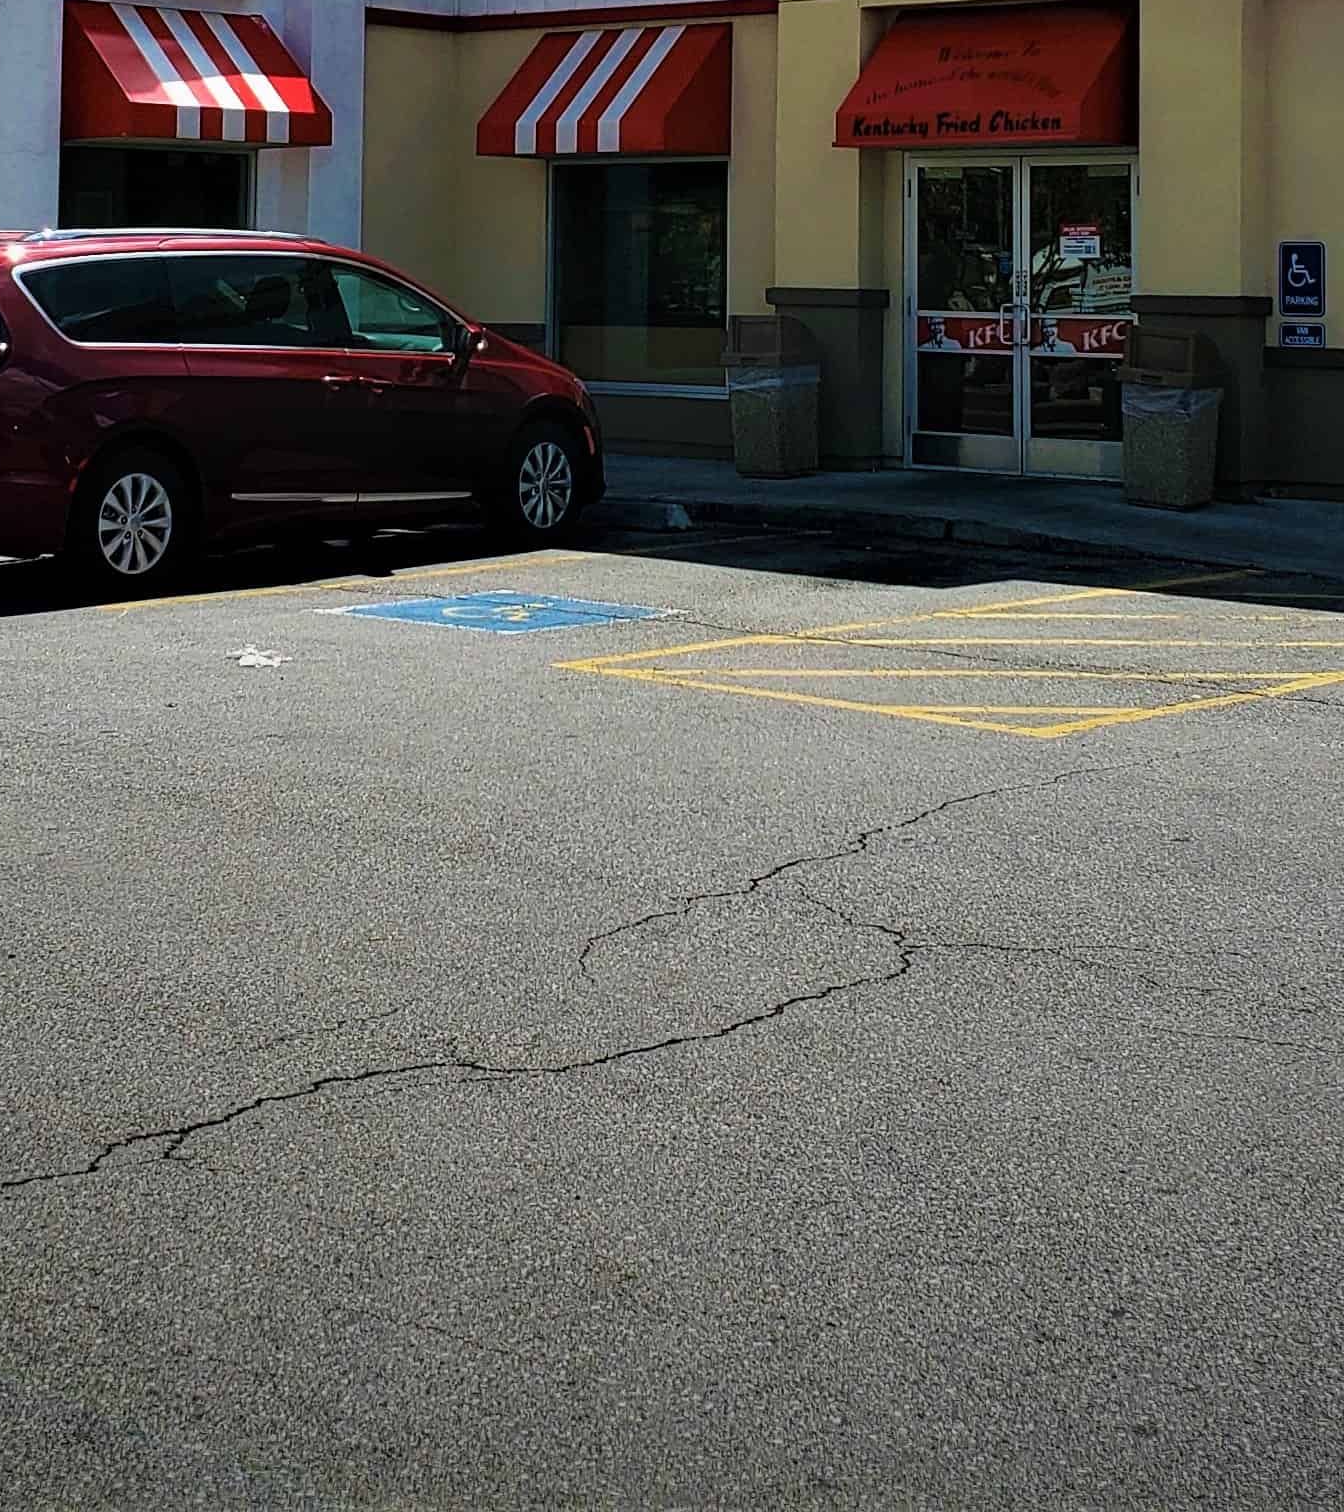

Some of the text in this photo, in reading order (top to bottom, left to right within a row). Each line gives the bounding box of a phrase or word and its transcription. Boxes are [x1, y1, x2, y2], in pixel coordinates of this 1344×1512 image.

[853, 109, 1061, 138] Kentucky Fried Chicken
[1286, 296, 1320, 306] PARKING
[968, 321, 1011, 349] KFC
[1082, 320, 1128, 352] KFC
